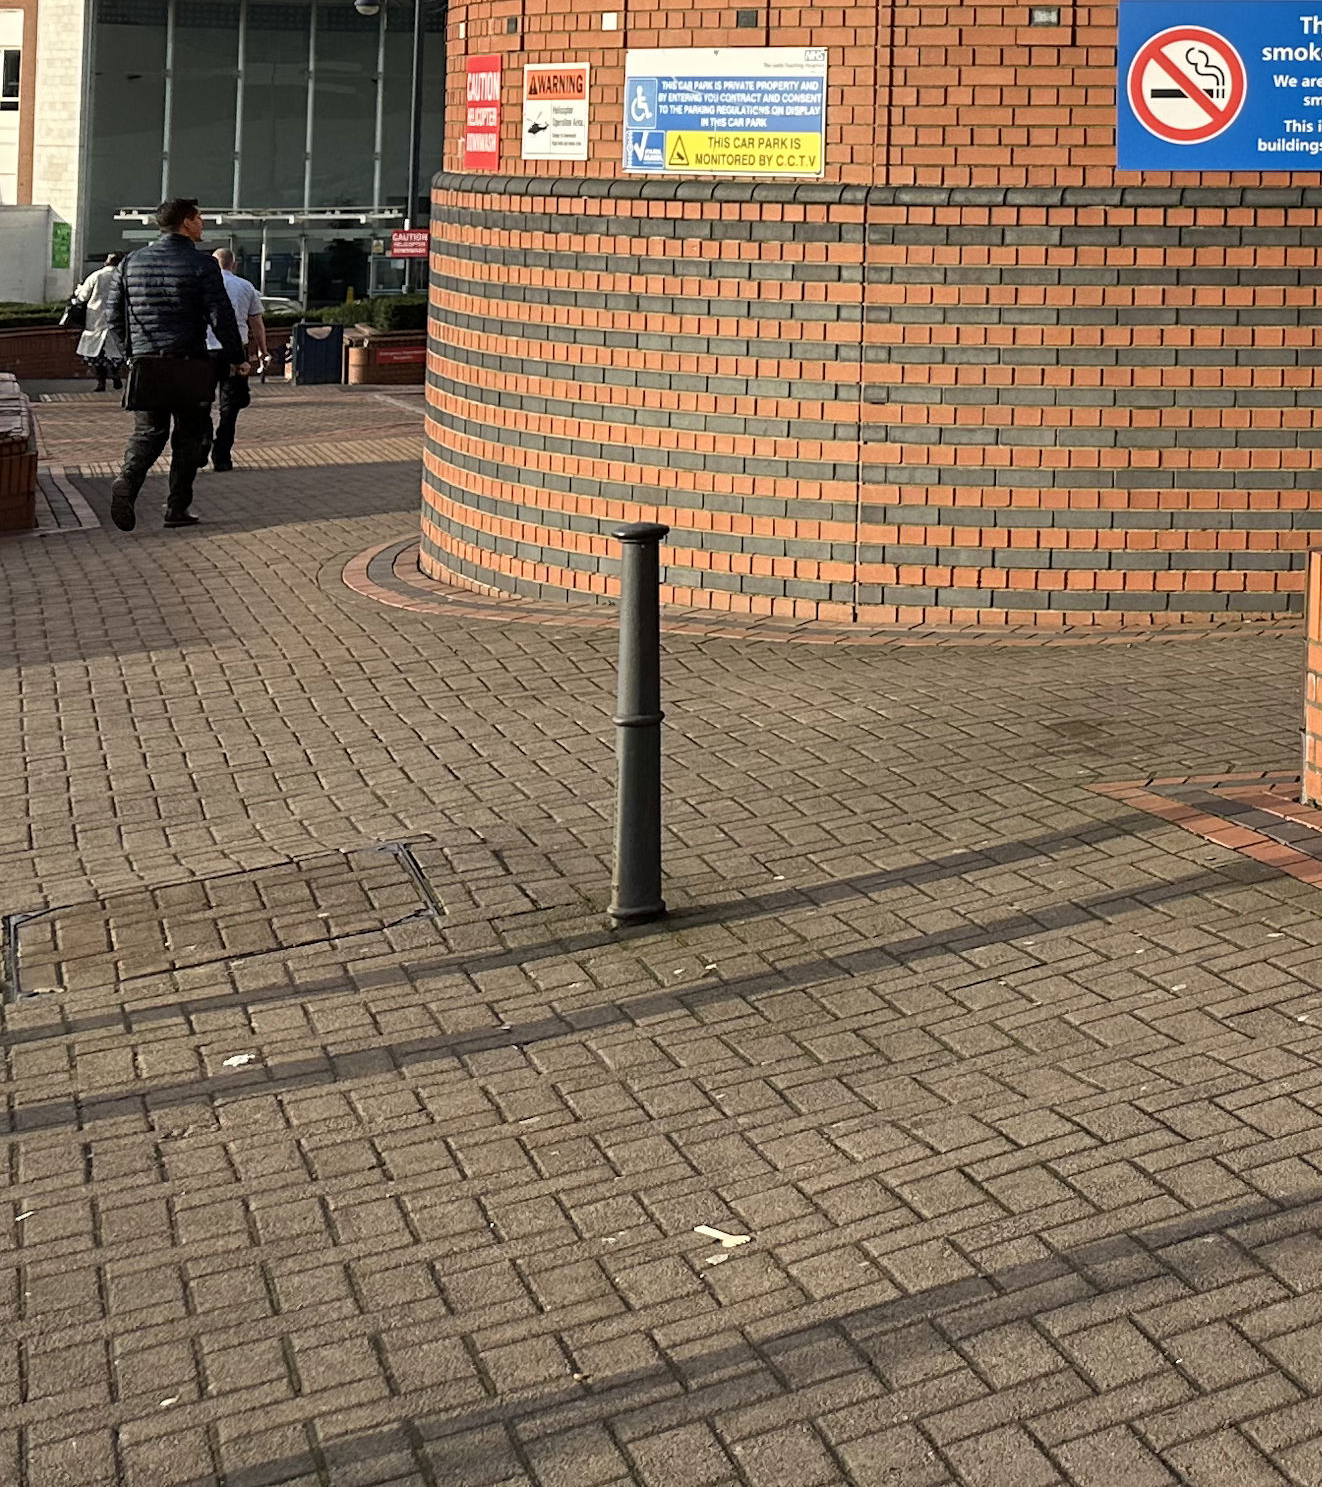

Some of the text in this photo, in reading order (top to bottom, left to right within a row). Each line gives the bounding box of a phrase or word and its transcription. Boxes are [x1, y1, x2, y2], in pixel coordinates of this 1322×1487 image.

[467, 71, 500, 101] CAUTION
[538, 75, 583, 94] WARNING
[662, 81, 819, 91] THIS CAR PARK IS PRIVATE PROPERTY AND
[1273, 75, 1297, 88] We
[658, 93, 822, 103] BY ENTERING YOU CONTRACT AND CONSENT
[659, 105, 820, 116] TO THE PARKING REGULATIONS ON DISPLAY
[700, 118, 768, 128] IN THIS CAR PARK
[1283, 119, 1313, 133] This
[708, 136, 801, 150] THIS CAR PARK IS
[695, 153, 816, 167] MONITORED BY C.C.T.V
[392, 232, 428, 242] CAUTION
